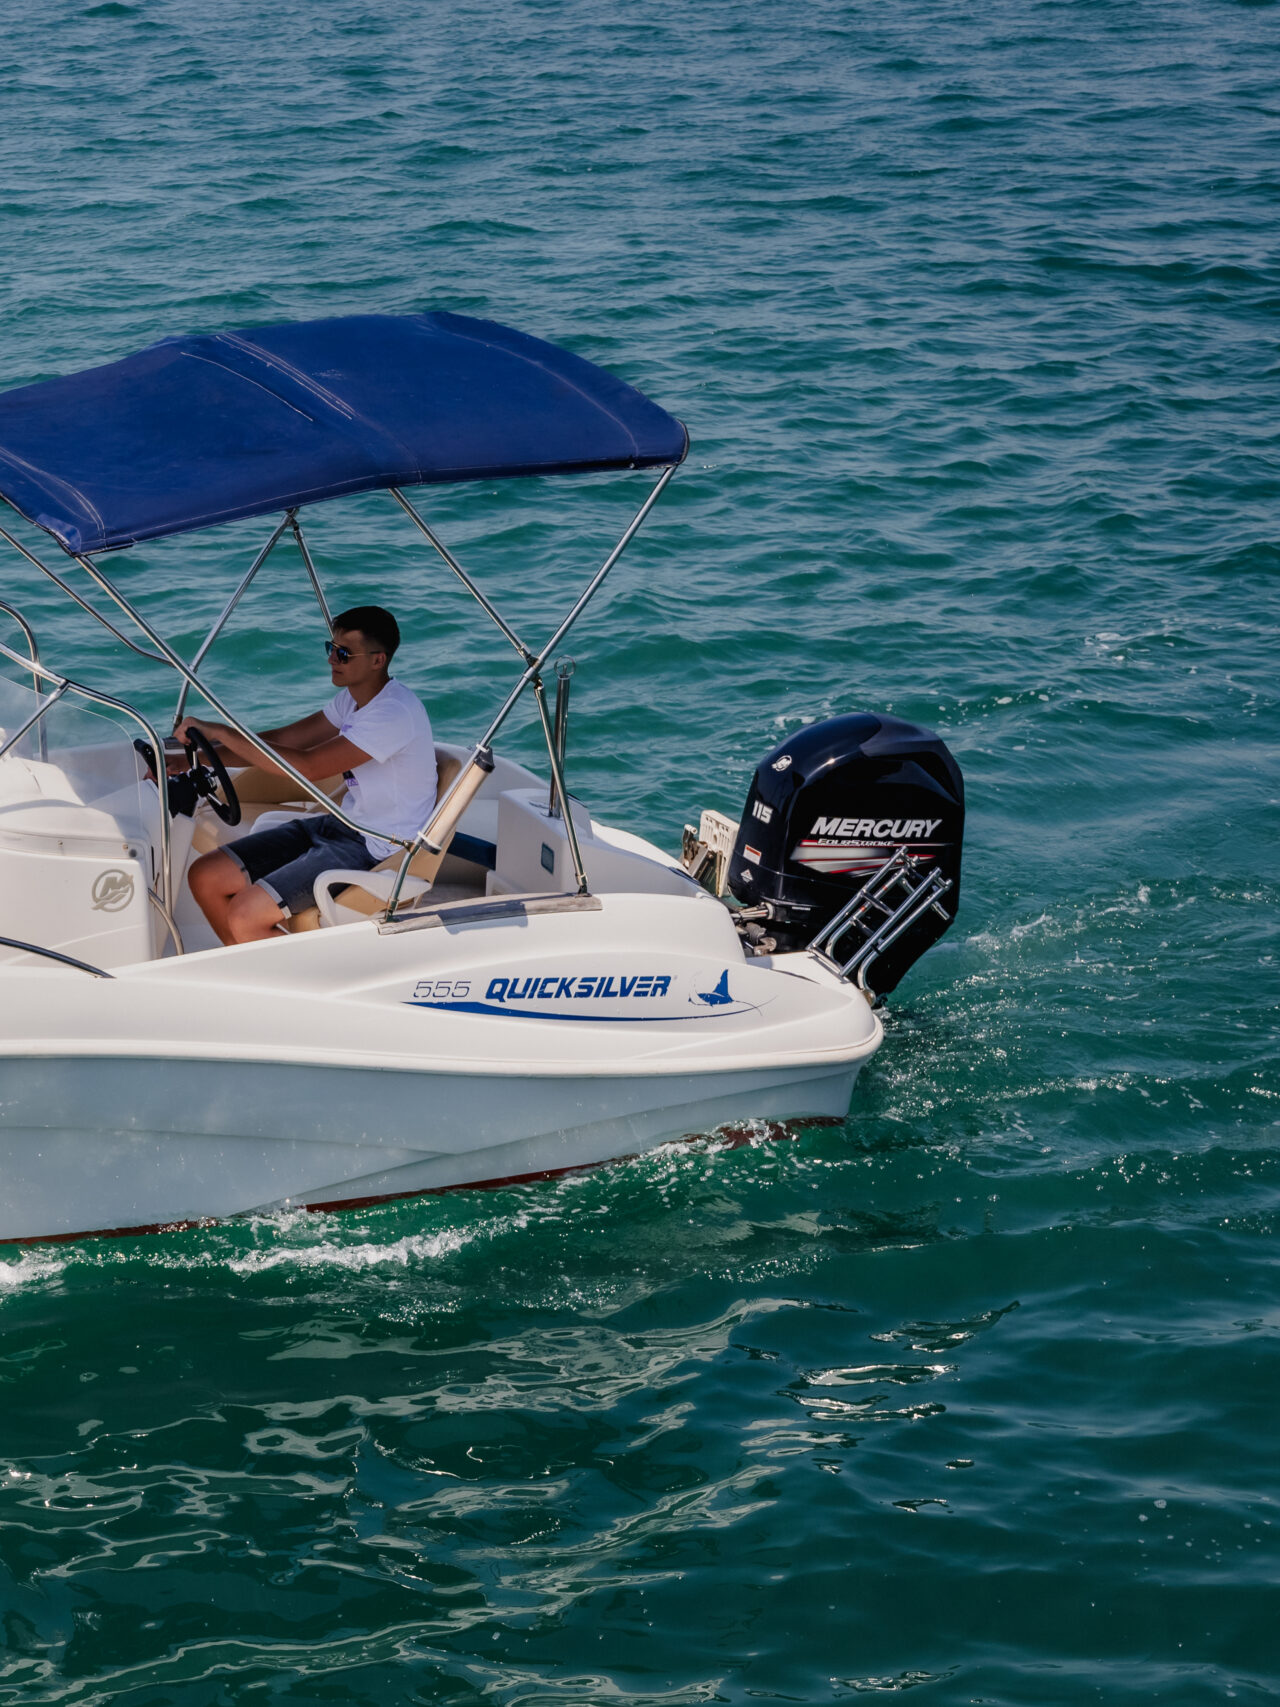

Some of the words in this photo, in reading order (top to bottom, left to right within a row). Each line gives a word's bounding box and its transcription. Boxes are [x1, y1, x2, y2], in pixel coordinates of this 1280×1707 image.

[752, 800, 774, 824] 115
[810, 816, 942, 838] MERCURY
[413, 981, 471, 998] 555
[485, 976, 671, 1003] QUICKSILVER
